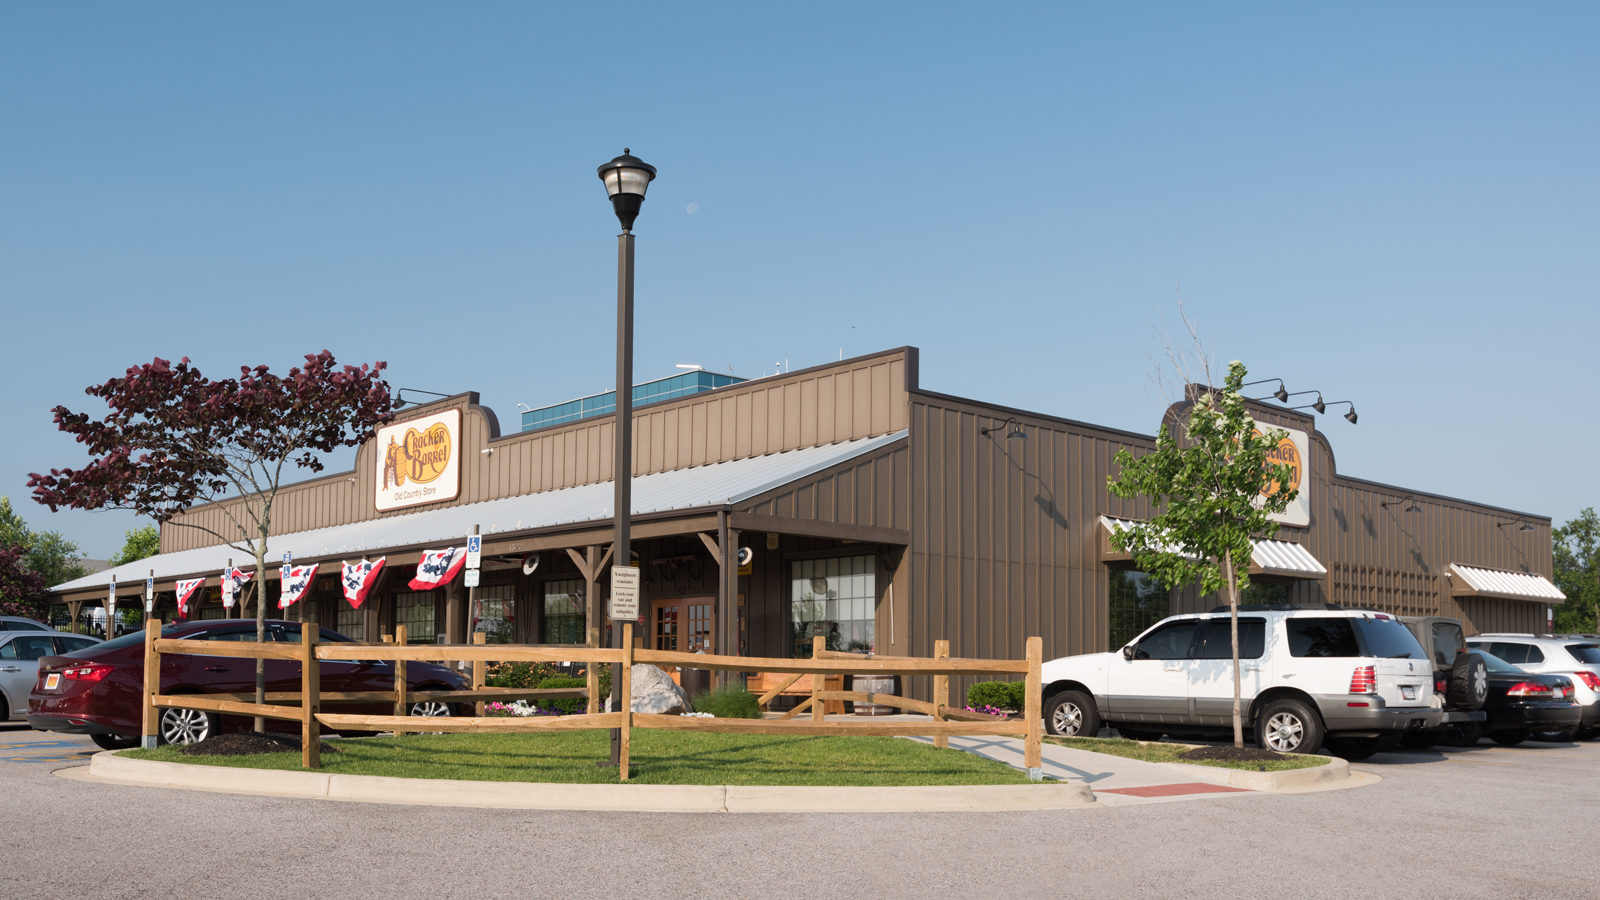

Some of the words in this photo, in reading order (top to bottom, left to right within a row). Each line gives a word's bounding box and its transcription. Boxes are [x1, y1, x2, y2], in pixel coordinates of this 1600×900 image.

[404, 430, 445, 460] Cracker
[412, 444, 447, 481] Barrel
[394, 491, 403, 501] Old
[403, 488, 423, 500] Country
[423, 486, 437, 496] Store
